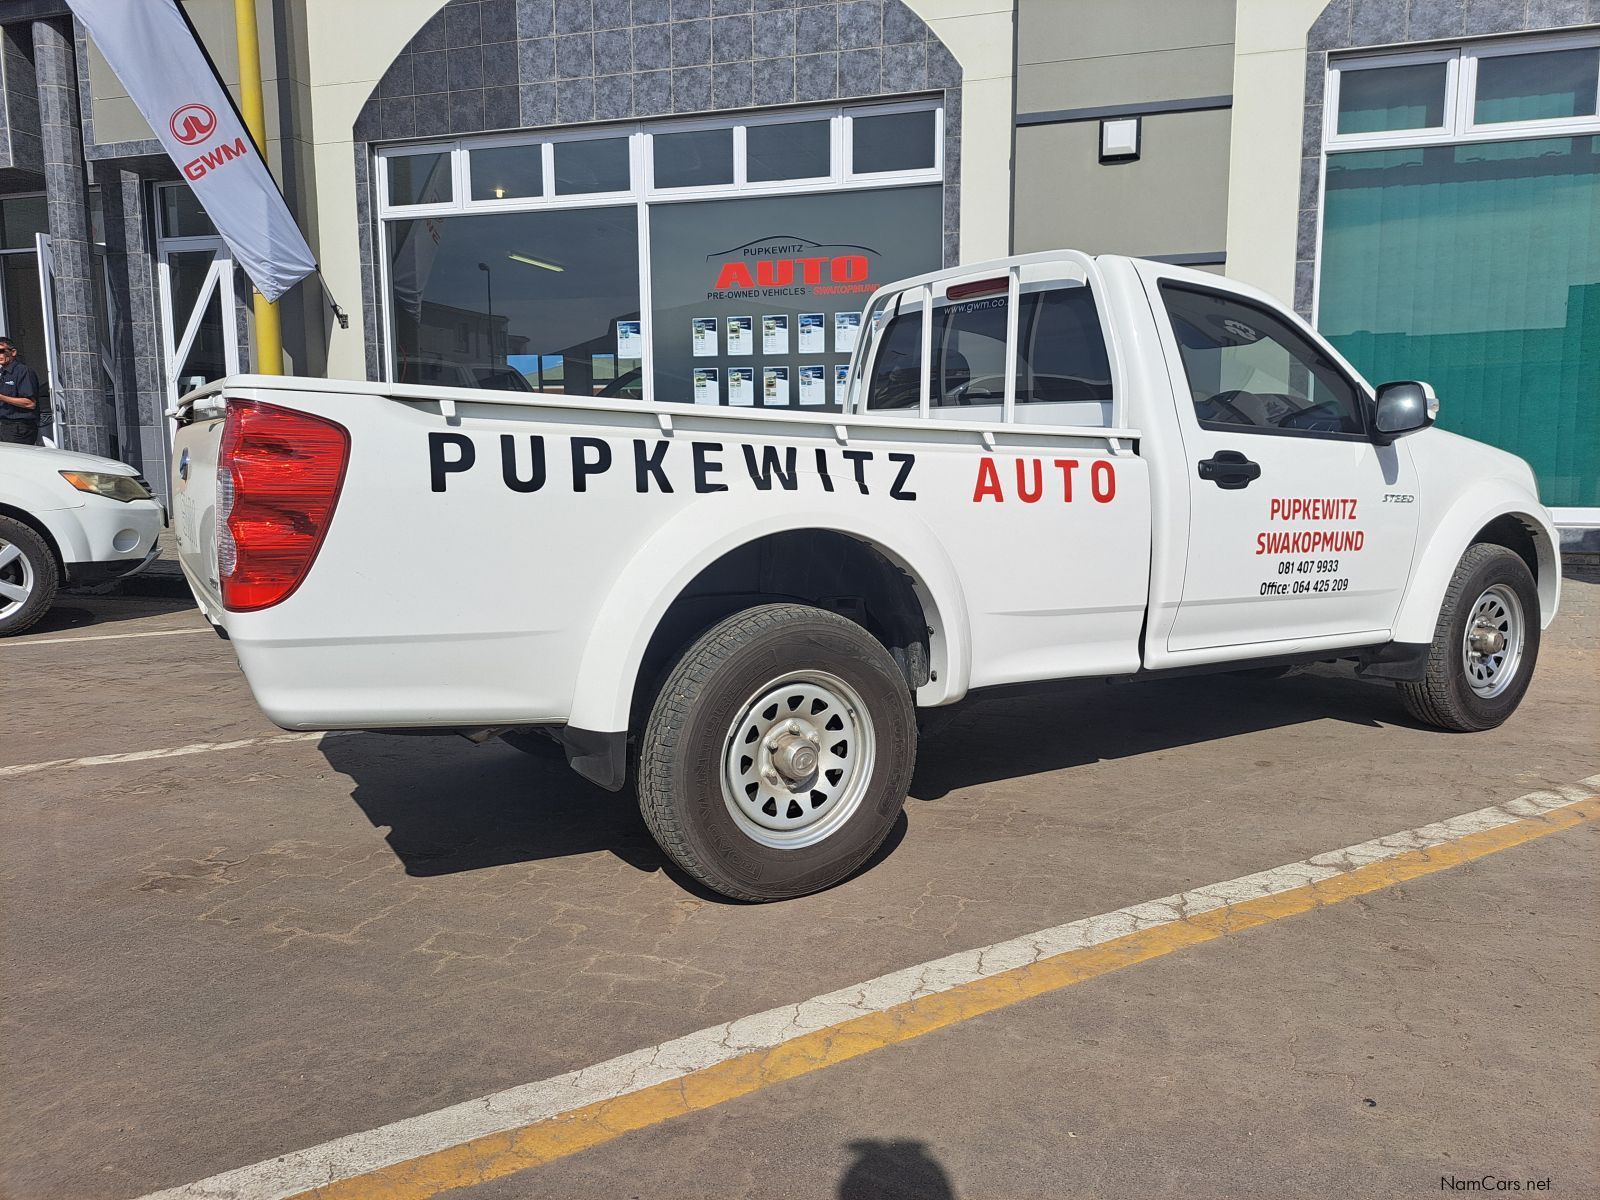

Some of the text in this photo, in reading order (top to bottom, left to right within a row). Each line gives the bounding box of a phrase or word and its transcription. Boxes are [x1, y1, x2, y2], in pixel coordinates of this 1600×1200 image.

[183, 137, 247, 181] GWM
[743, 244, 804, 257] PUPKEWITZ
[715, 255, 868, 289] AUTO
[707, 289, 760, 300] PRE-OWNED
[763, 287, 806, 298] VEHICLES
[944, 298, 1009, 315] www.gwm.co.
[428, 432, 917, 501] PUPKEWITZ
[972, 457, 1117, 504] AUTO
[1382, 494, 1415, 504] STEED
[1270, 498, 1358, 521] PUPKEWITZ
[1255, 530, 1365, 555] SWAKOPMUND
[1278, 559, 1339, 575] 081 407 9933
[1259, 578, 1349, 596] Office: 064 425 209
